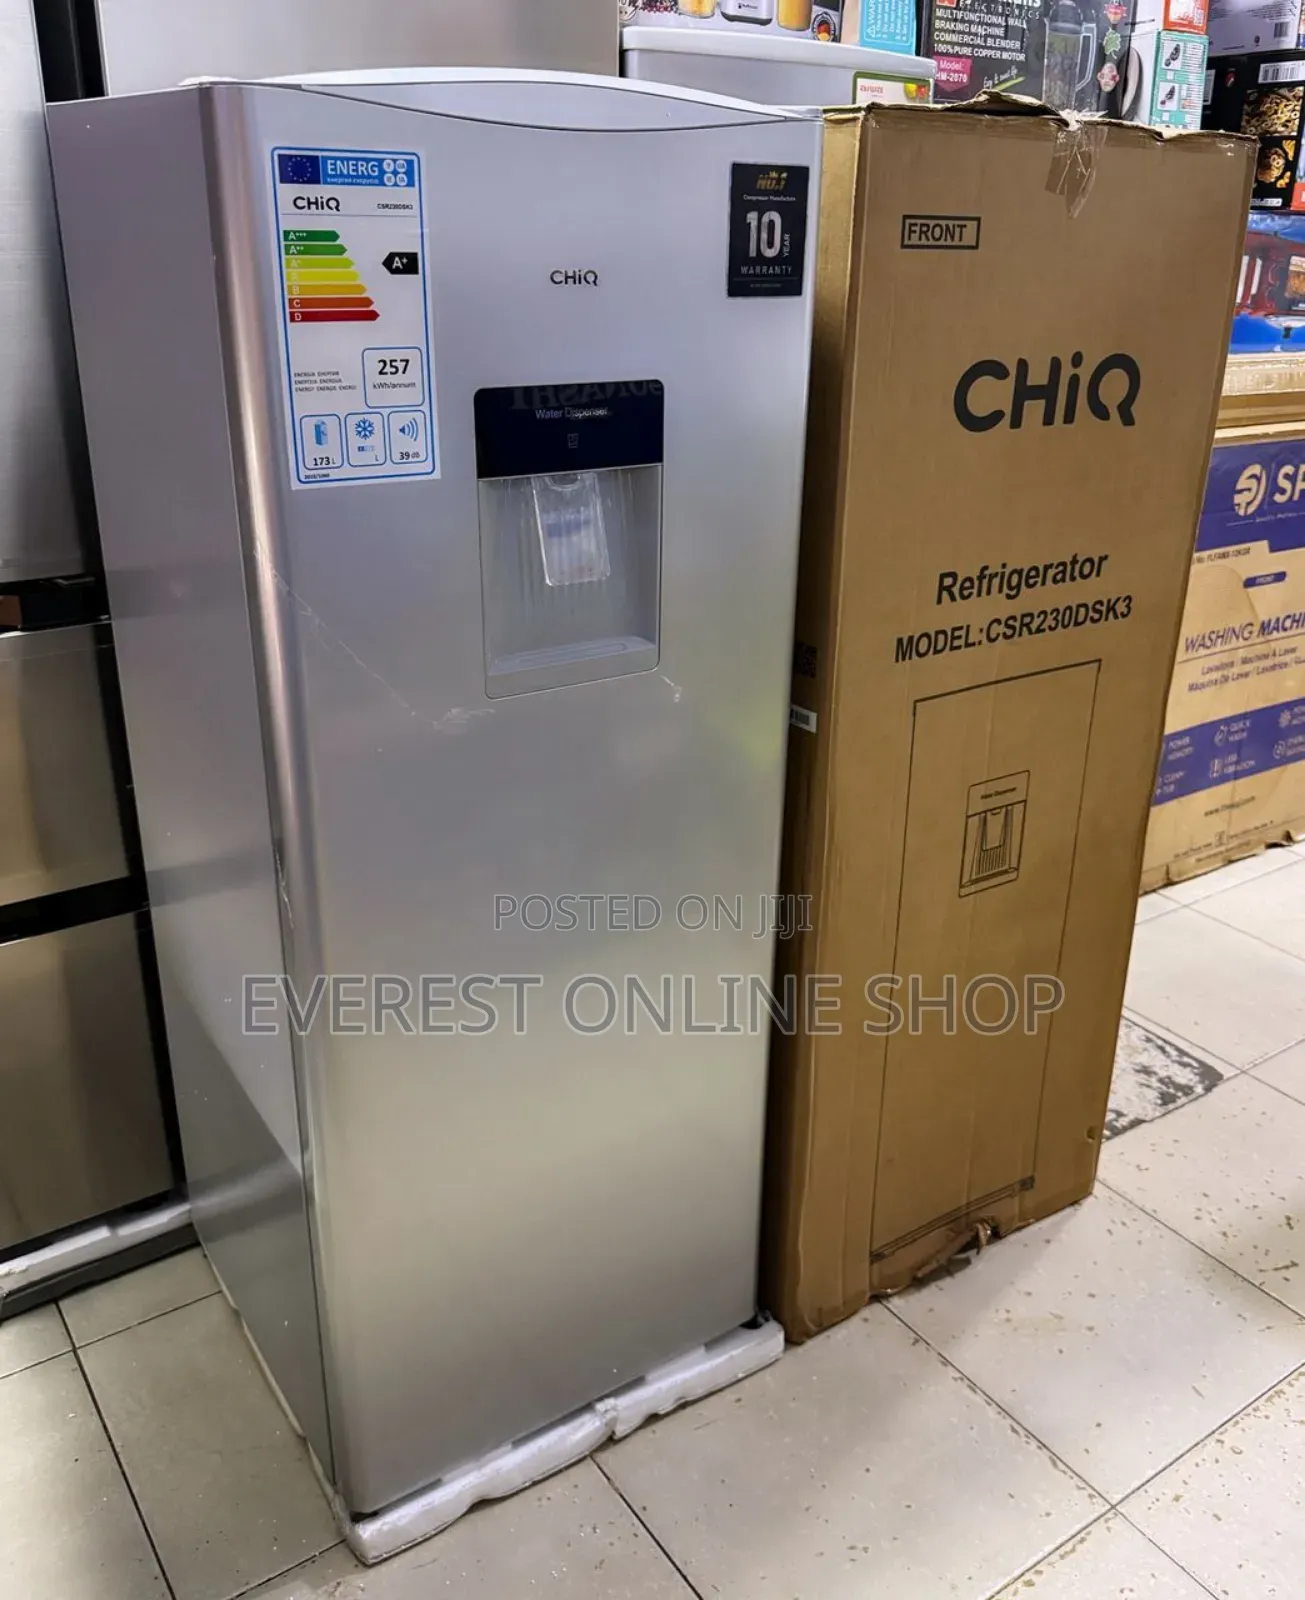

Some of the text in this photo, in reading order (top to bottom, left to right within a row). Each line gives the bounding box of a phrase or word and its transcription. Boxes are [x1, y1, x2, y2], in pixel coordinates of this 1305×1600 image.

[934, 20, 1005, 37] BRAKING MACHINE
[934, 31, 1021, 50] COMMERCIAL BLENDER
[973, 48, 1001, 59] COPPER
[1002, 51, 1026, 62] MOTOR
[327, 159, 380, 176] ENERG
[293, 196, 341, 212] CHiQ
[746, 210, 782, 258] 10
[907, 222, 967, 243] FRONT
[392, 257, 408, 269] A+
[741, 265, 792, 275] WARRANTY
[549, 269, 598, 286] CHiQ
[293, 299, 301, 307] C
[294, 313, 302, 321] D
[377, 358, 410, 376] 257
[953, 351, 1141, 432] CHiQ
[535, 409, 563, 420] Water
[313, 456, 331, 466] 173
[399, 451, 410, 460] 39
[936, 553, 1109, 605] Refrigerator
[894, 594, 1133, 663] MODEL:CSR230DSK3
[1184, 622, 1254, 653] WASHING
